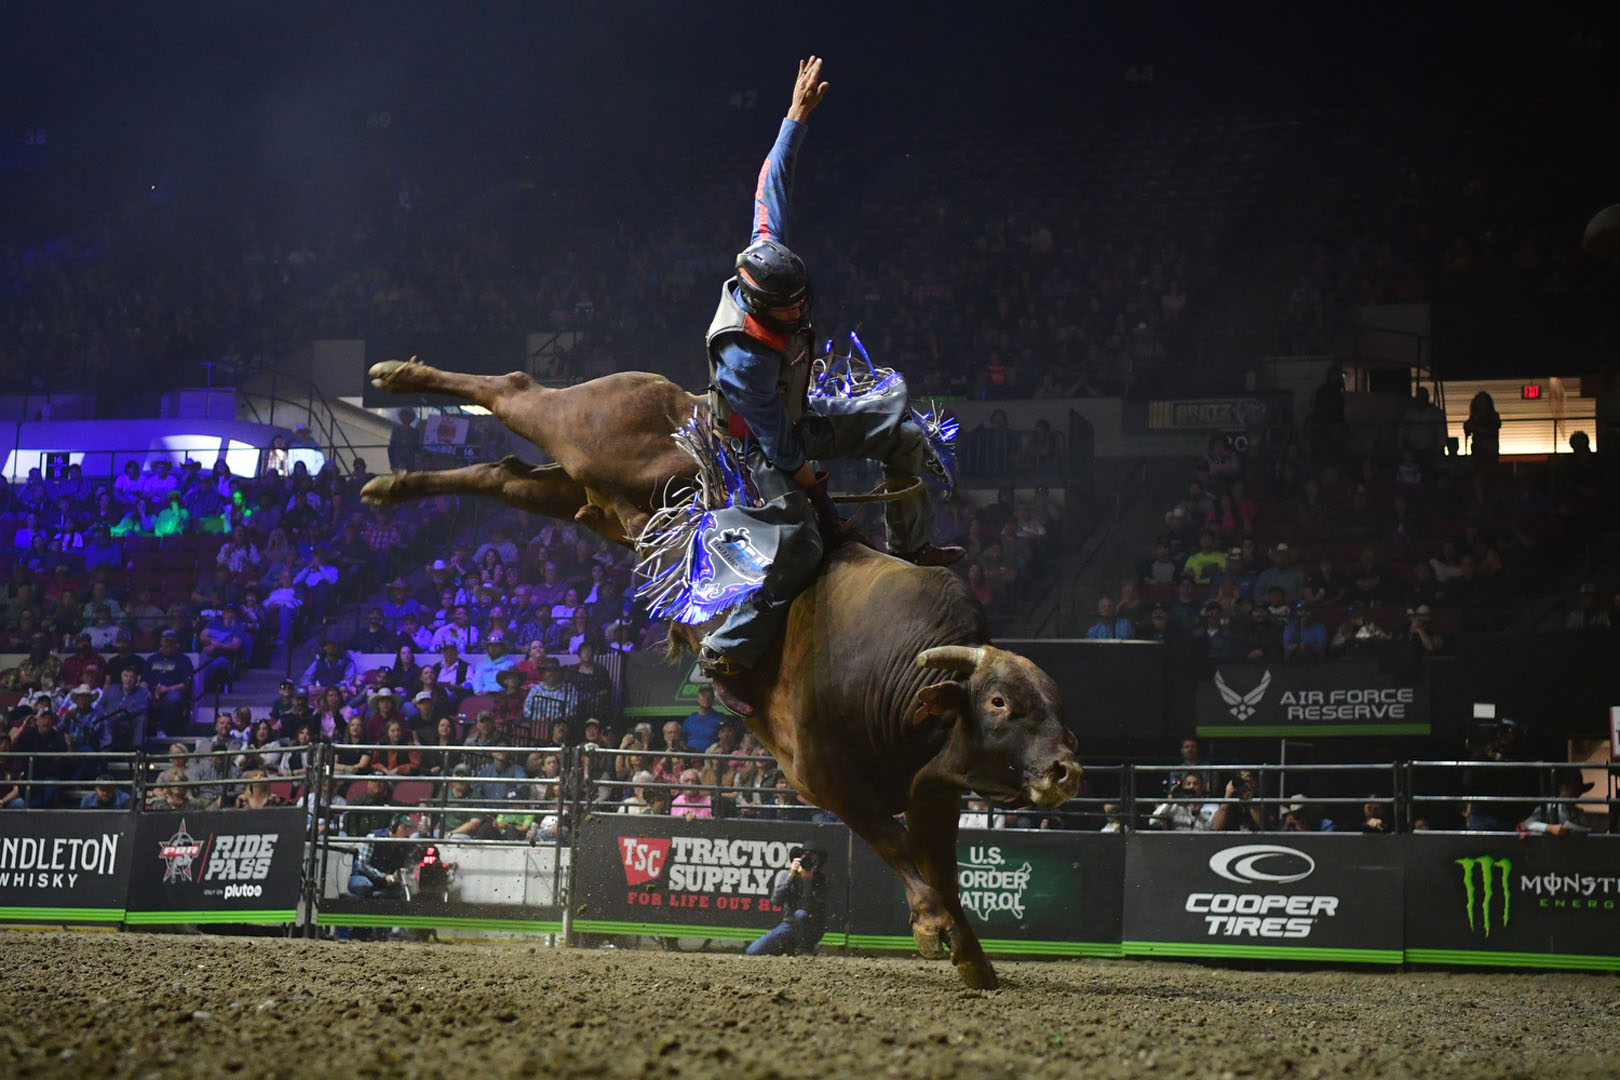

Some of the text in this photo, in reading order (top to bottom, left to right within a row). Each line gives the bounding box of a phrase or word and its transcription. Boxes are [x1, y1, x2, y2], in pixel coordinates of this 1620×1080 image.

[1280, 688, 1413, 705] AIR FORCE
[1287, 704, 1406, 720] RESERVE
[211, 833, 279, 859] RIDE
[970, 846, 1006, 864] U.S.
[623, 838, 661, 878] TSC
[204, 858, 272, 880] PASS
[0, 872, 78, 888] WHISKY
[668, 864, 774, 895] SUPPLY
[958, 870, 1027, 889] ORDER
[627, 892, 662, 905] FOR
[670, 893, 709, 908] LIFE
[716, 896, 752, 911] OUT
[959, 891, 1026, 911] ATROL
[1185, 893, 1339, 917] COOPER
[1539, 898, 1614, 909] ENERG
[1204, 915, 1314, 938] TIRES
